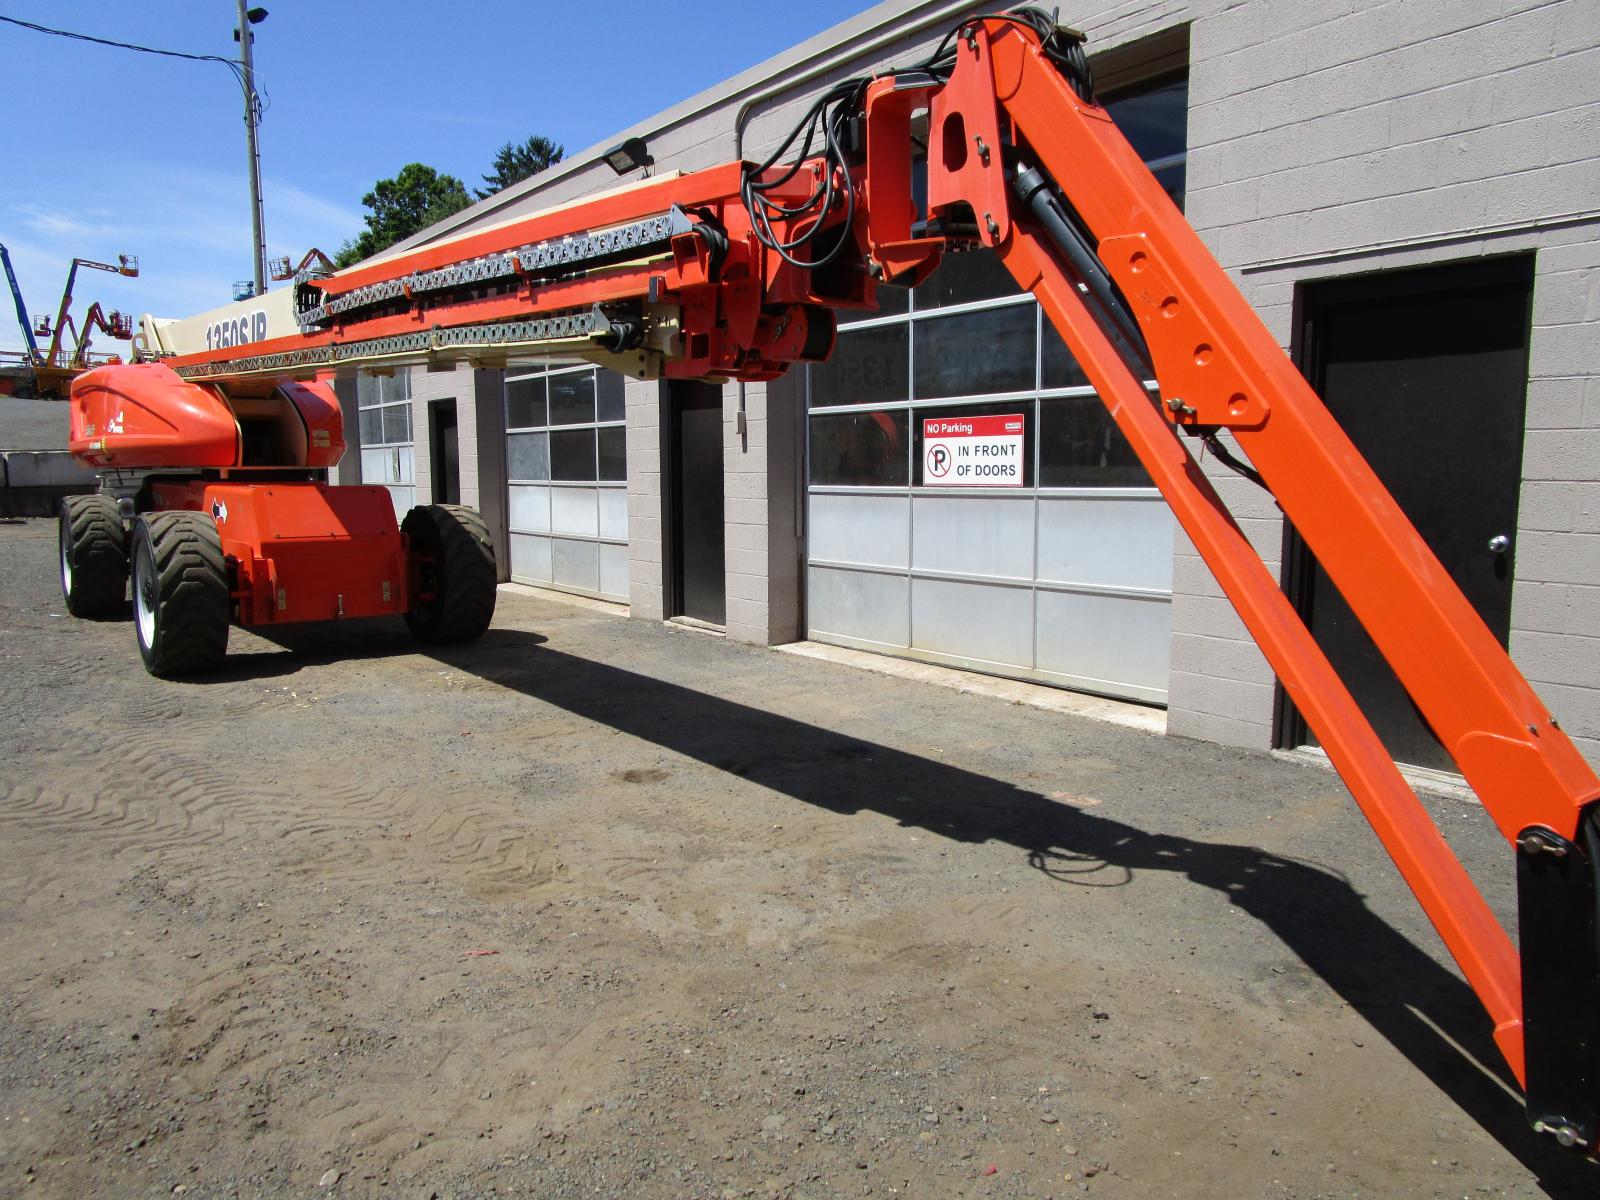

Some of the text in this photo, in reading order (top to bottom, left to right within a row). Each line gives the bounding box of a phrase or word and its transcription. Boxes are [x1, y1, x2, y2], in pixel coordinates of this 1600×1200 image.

[927, 423, 973, 434] NO Parking
[958, 445, 1016, 456] IN FRONT
[957, 465, 1016, 476] OF DOORS
